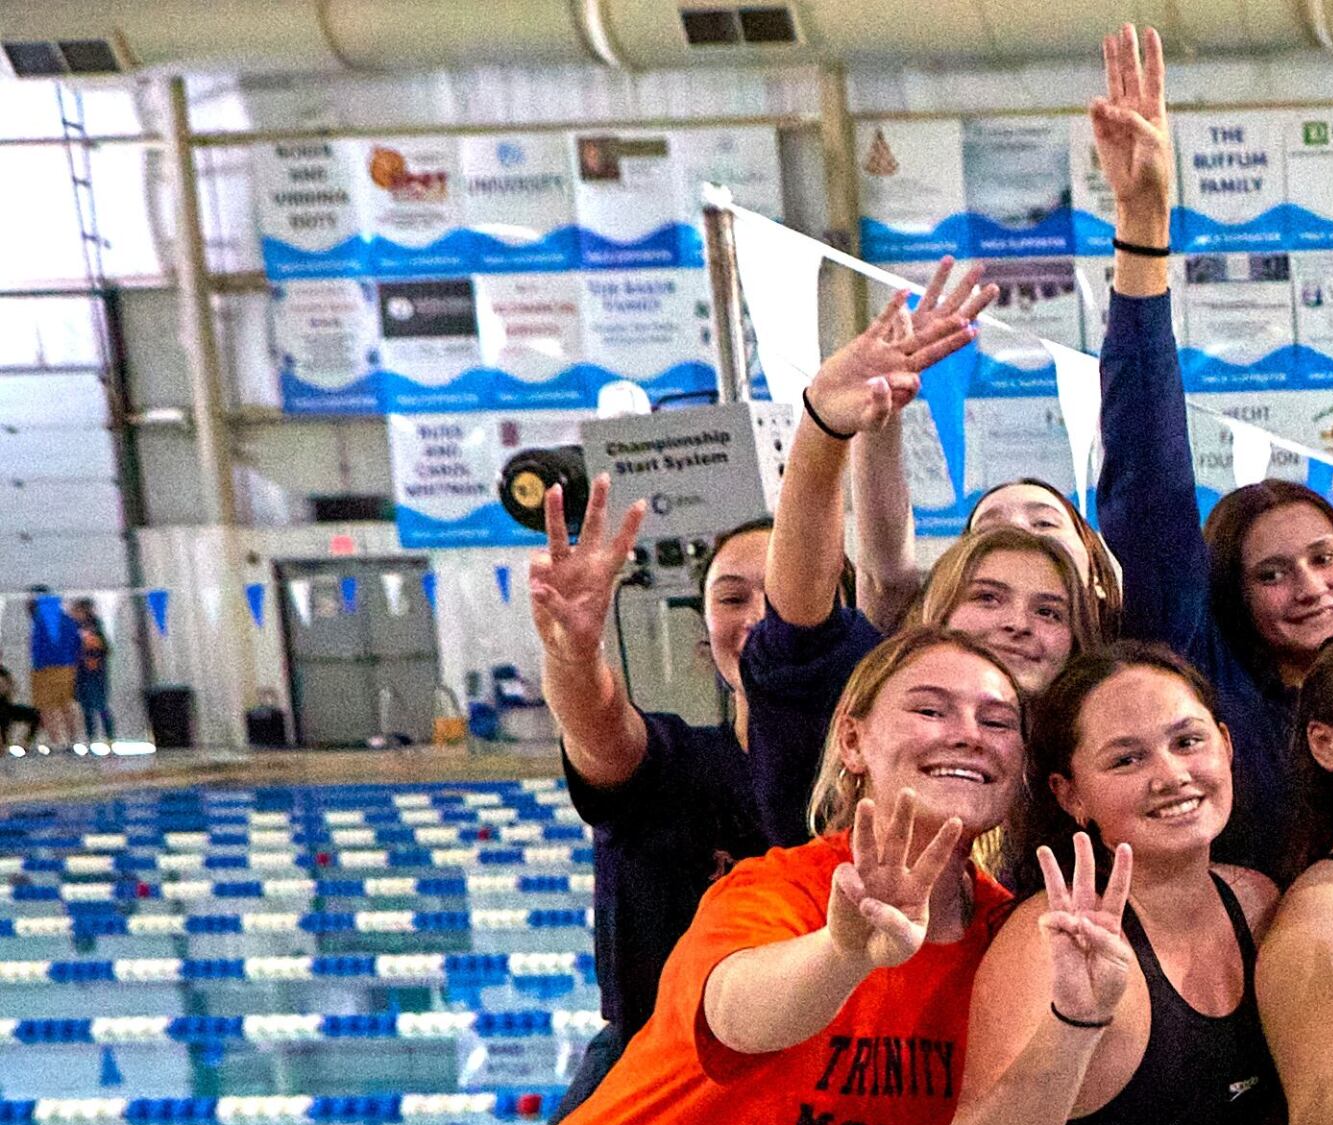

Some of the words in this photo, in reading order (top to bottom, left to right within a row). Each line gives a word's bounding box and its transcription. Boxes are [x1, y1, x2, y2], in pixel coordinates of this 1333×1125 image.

[1210, 126, 1244, 144] THE
[1200, 177, 1263, 194] FAMILY
[606, 430, 732, 456] Championship
[615, 458, 660, 475] Start
[662, 451, 729, 472] System
[814, 1034, 955, 1101] TRINITY
